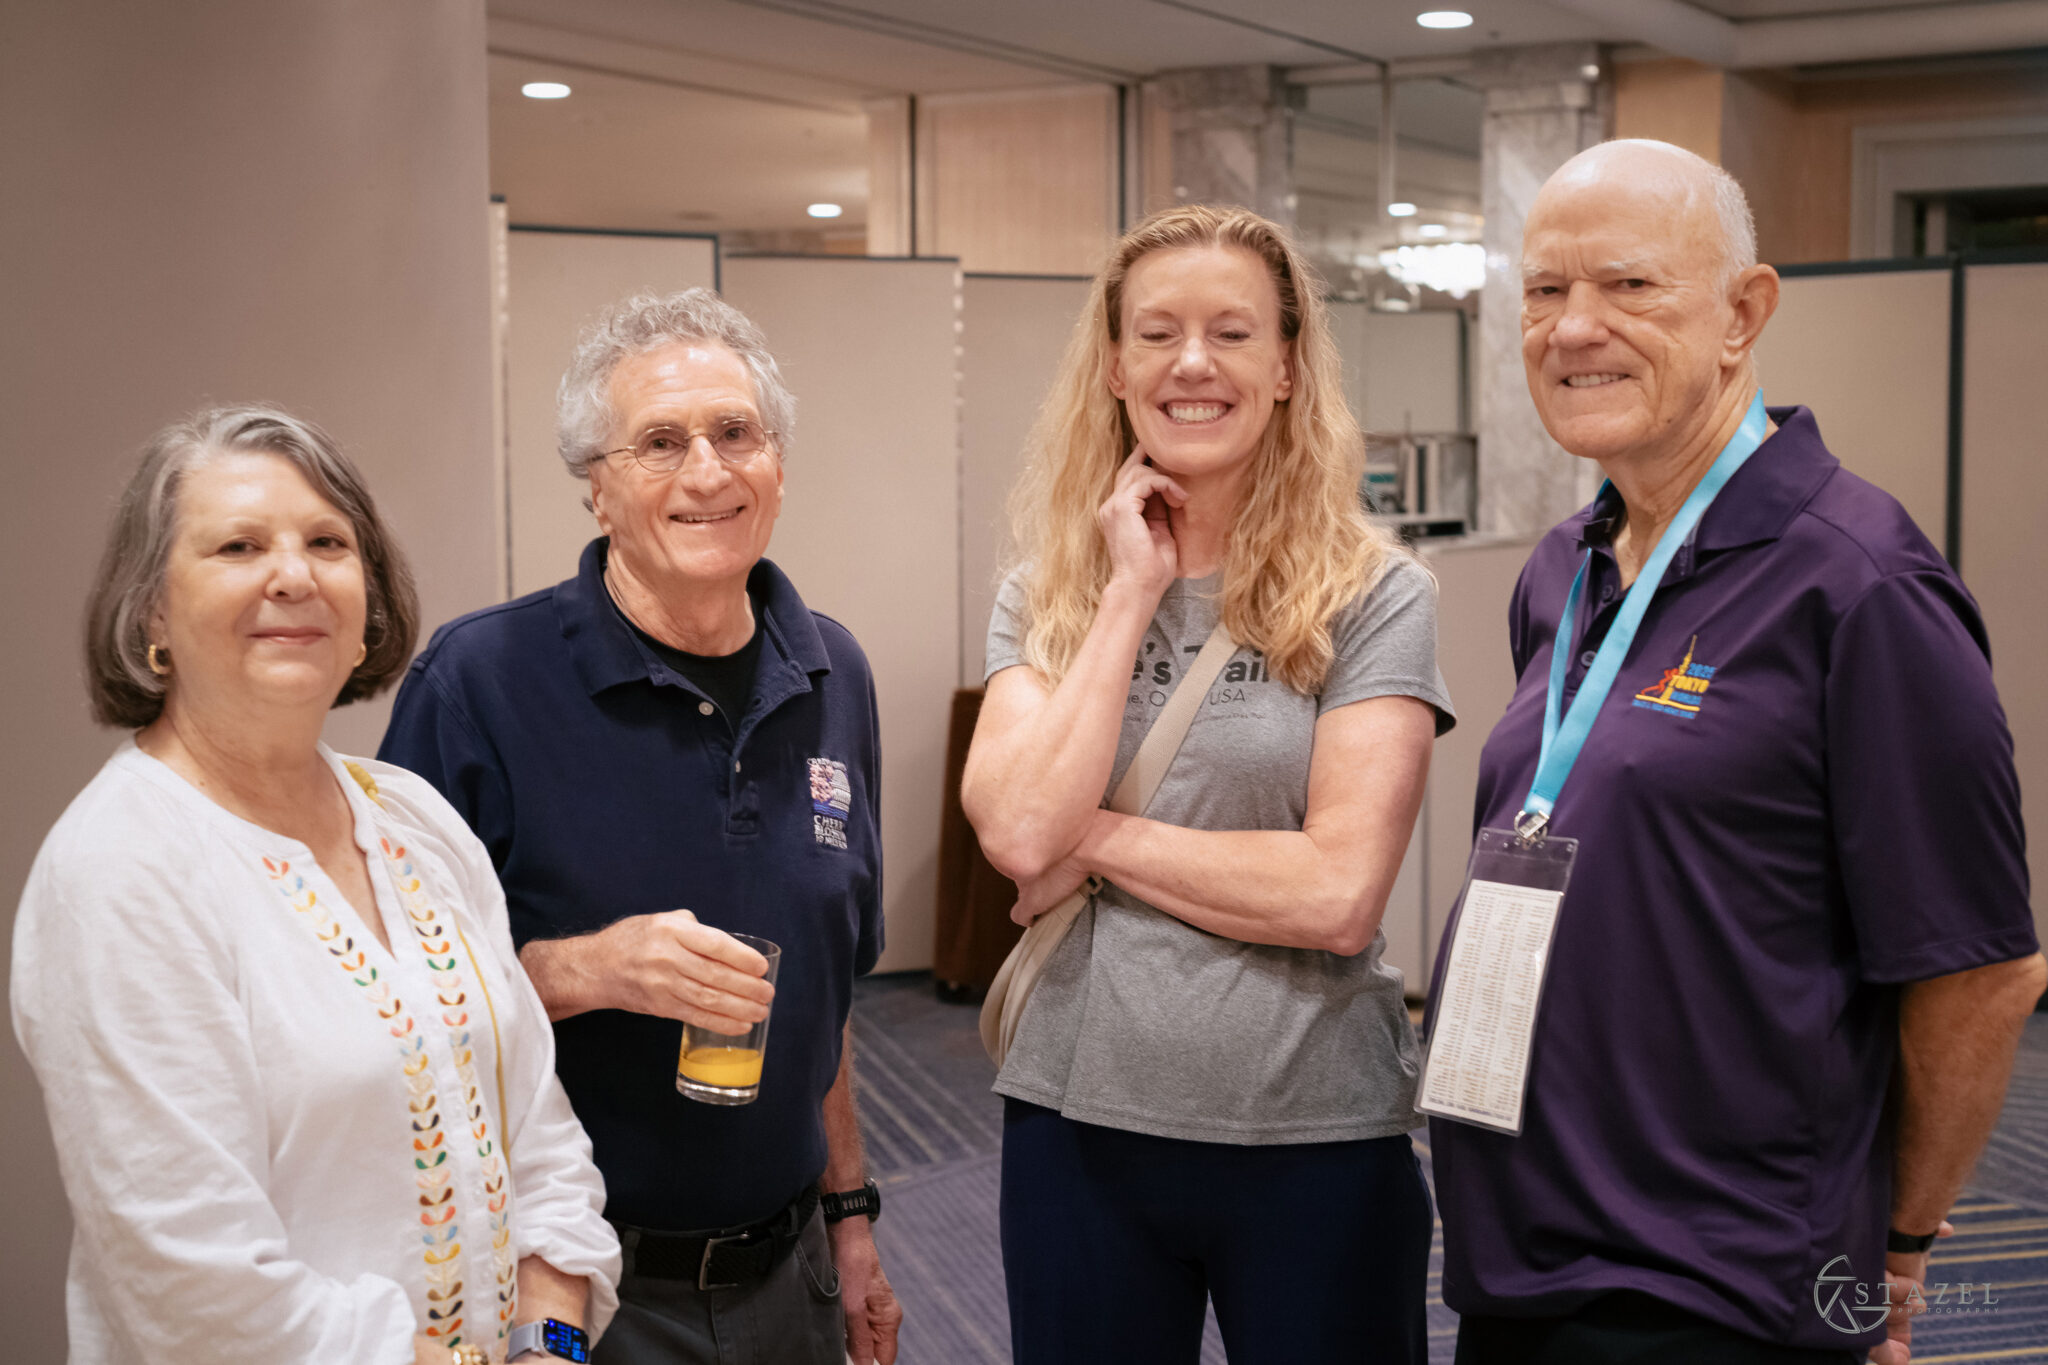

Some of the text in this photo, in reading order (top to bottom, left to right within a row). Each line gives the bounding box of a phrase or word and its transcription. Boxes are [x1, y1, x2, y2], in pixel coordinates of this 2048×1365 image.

[1149, 691, 1167, 707] O
[1210, 689, 1246, 706] USA
[814, 815, 845, 830] CHERR
